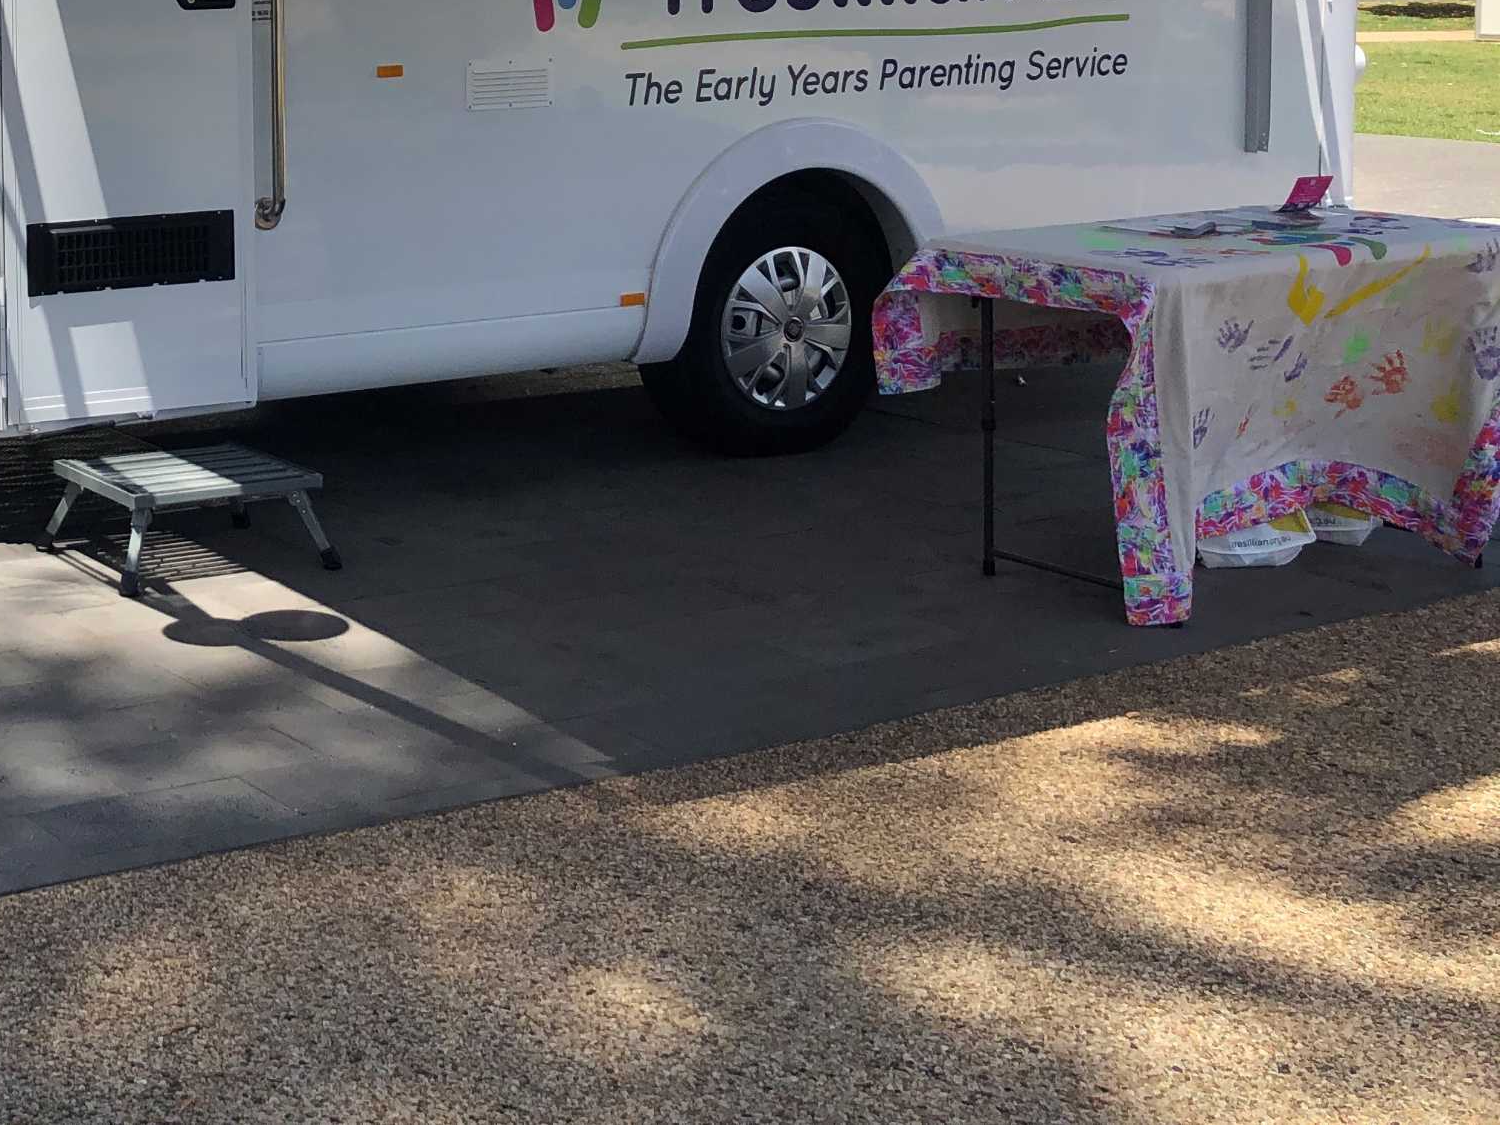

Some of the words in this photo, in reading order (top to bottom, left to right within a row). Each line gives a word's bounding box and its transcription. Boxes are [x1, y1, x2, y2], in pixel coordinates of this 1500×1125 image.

[625, 72, 684, 106] The
[695, 66, 776, 107] Early
[787, 63, 869, 97] Years
[879, 53, 1016, 91] Parenting
[1026, 46, 1129, 81] Service
